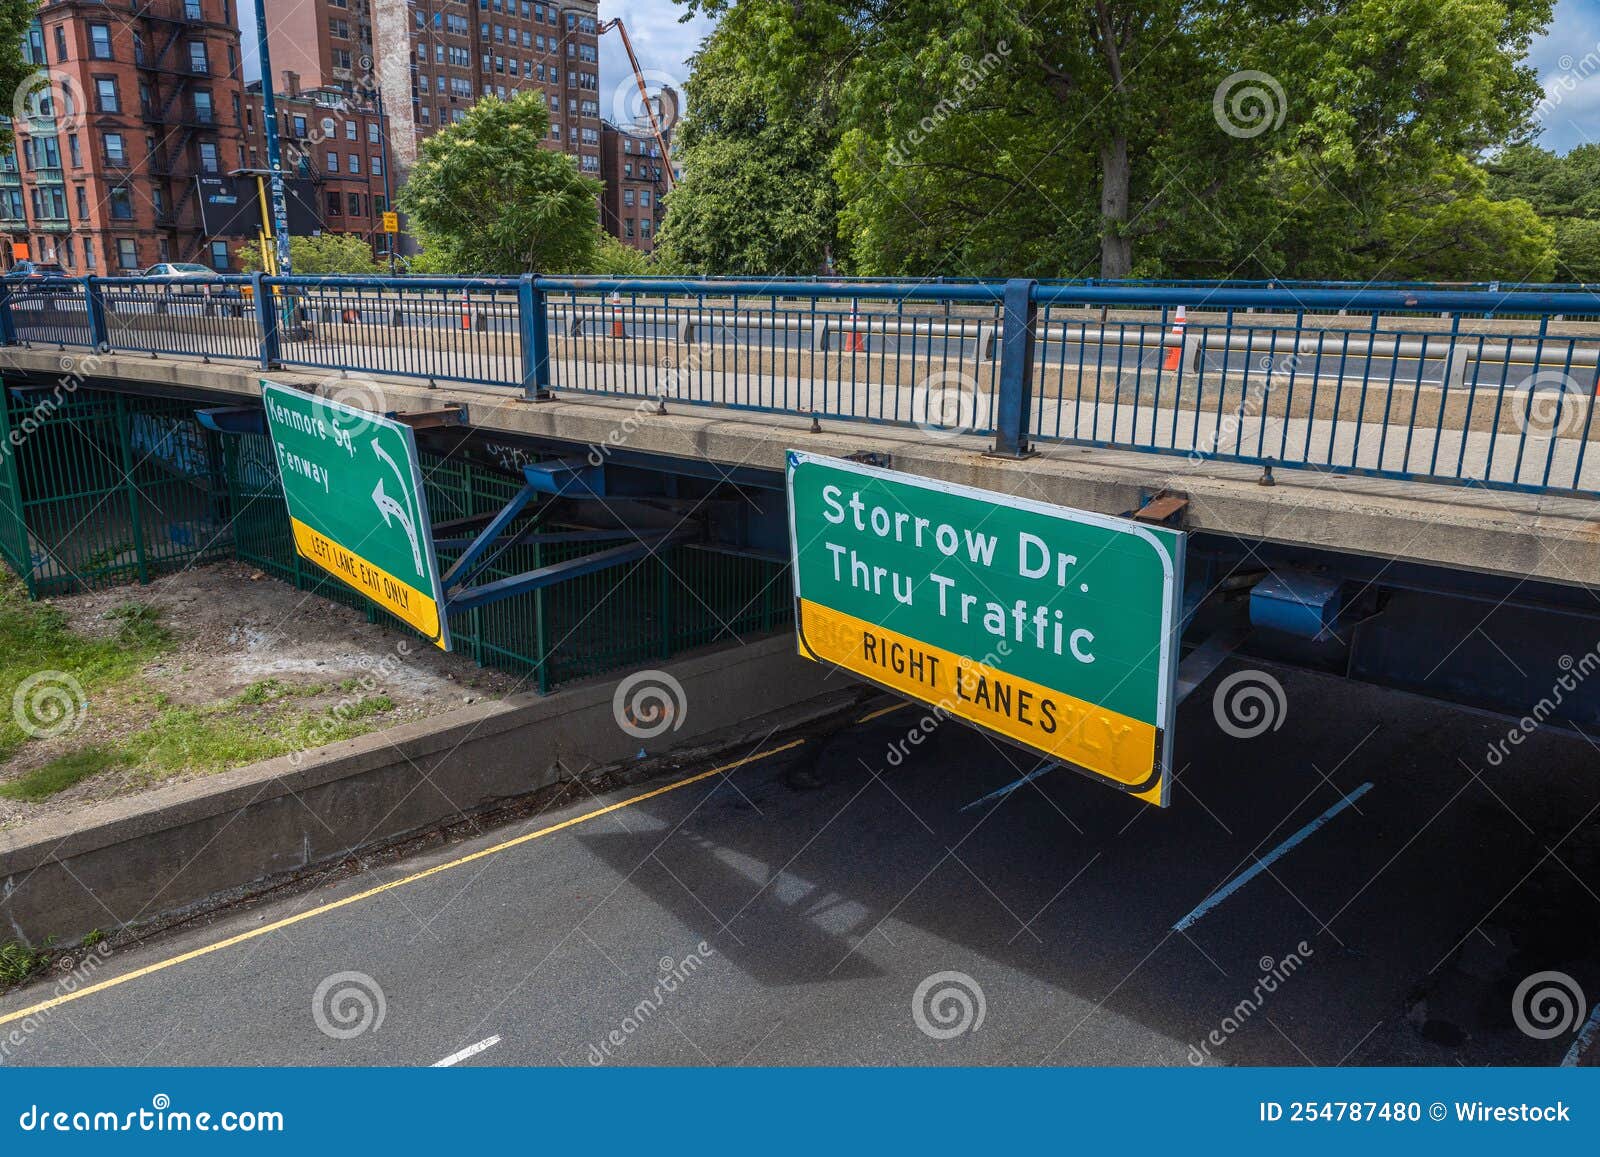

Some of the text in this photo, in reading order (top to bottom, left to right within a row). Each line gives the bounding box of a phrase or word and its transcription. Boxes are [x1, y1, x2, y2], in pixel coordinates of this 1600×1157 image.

[267, 396, 357, 458] Kenmore Sq.
[277, 441, 329, 494] Fenway
[311, 534, 409, 610] LEFT LANE EXIT ONLY
[822, 485, 1089, 593] Storrow Dr.
[825, 542, 913, 606] Thru
[930, 573, 1096, 664] Traffic
[863, 631, 939, 687] RIGHT
[956, 666, 1057, 734] LANES
